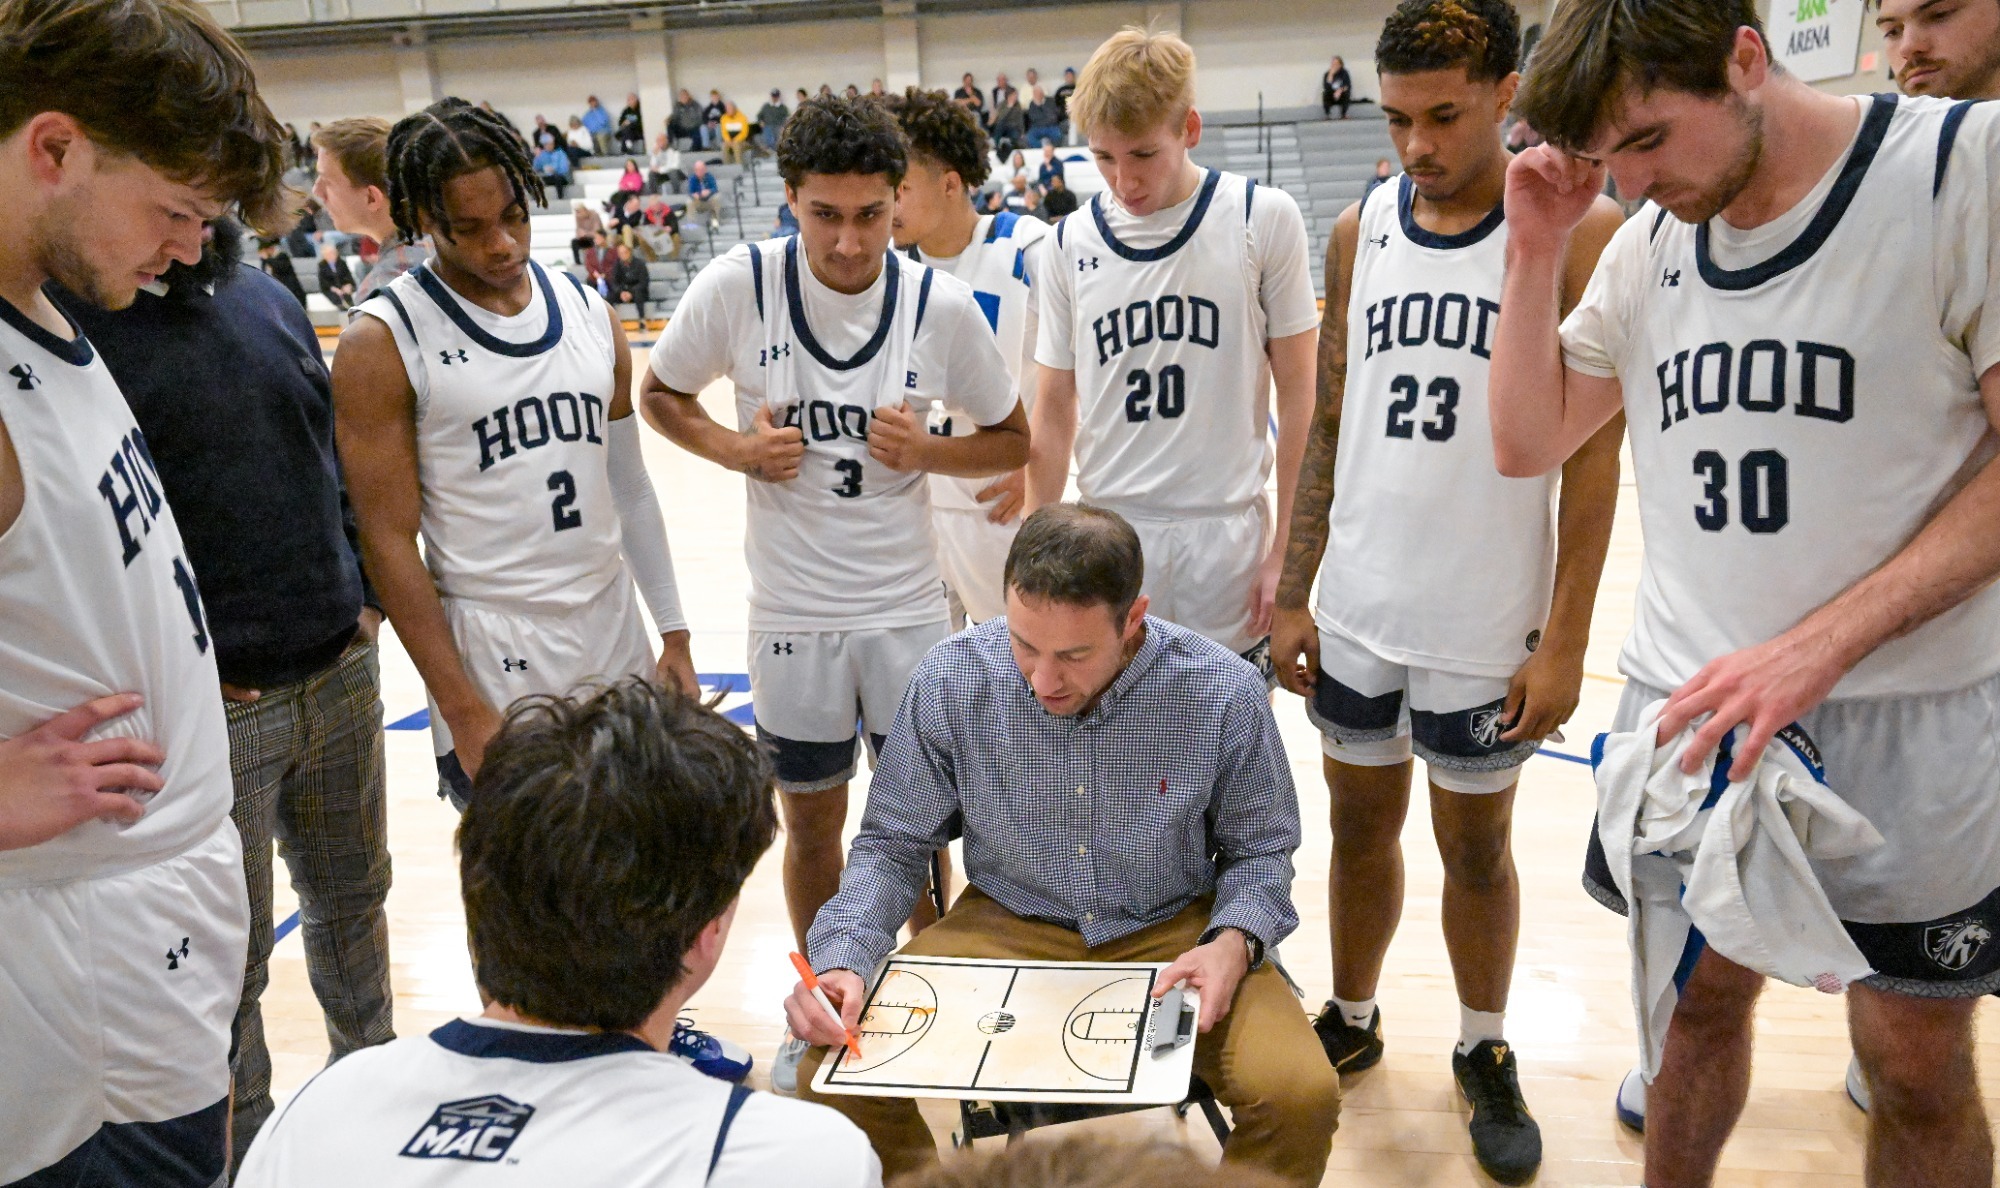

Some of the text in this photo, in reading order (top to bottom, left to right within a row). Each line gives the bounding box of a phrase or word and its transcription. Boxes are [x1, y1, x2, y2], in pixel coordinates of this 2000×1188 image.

[1786, 25, 1830, 56] ARENA
[1092, 294, 1220, 367] HOOD
[1125, 364, 1185, 423] 20
[1385, 374, 1461, 442] 23
[1656, 338, 1856, 433] HOOD
[472, 391, 604, 473] HOOD
[783, 400, 877, 447] HOO
[547, 469, 582, 532] 2
[831, 458, 864, 498] 3
[1692, 448, 1790, 535] 30
[407, 1125, 517, 1159] MAC
